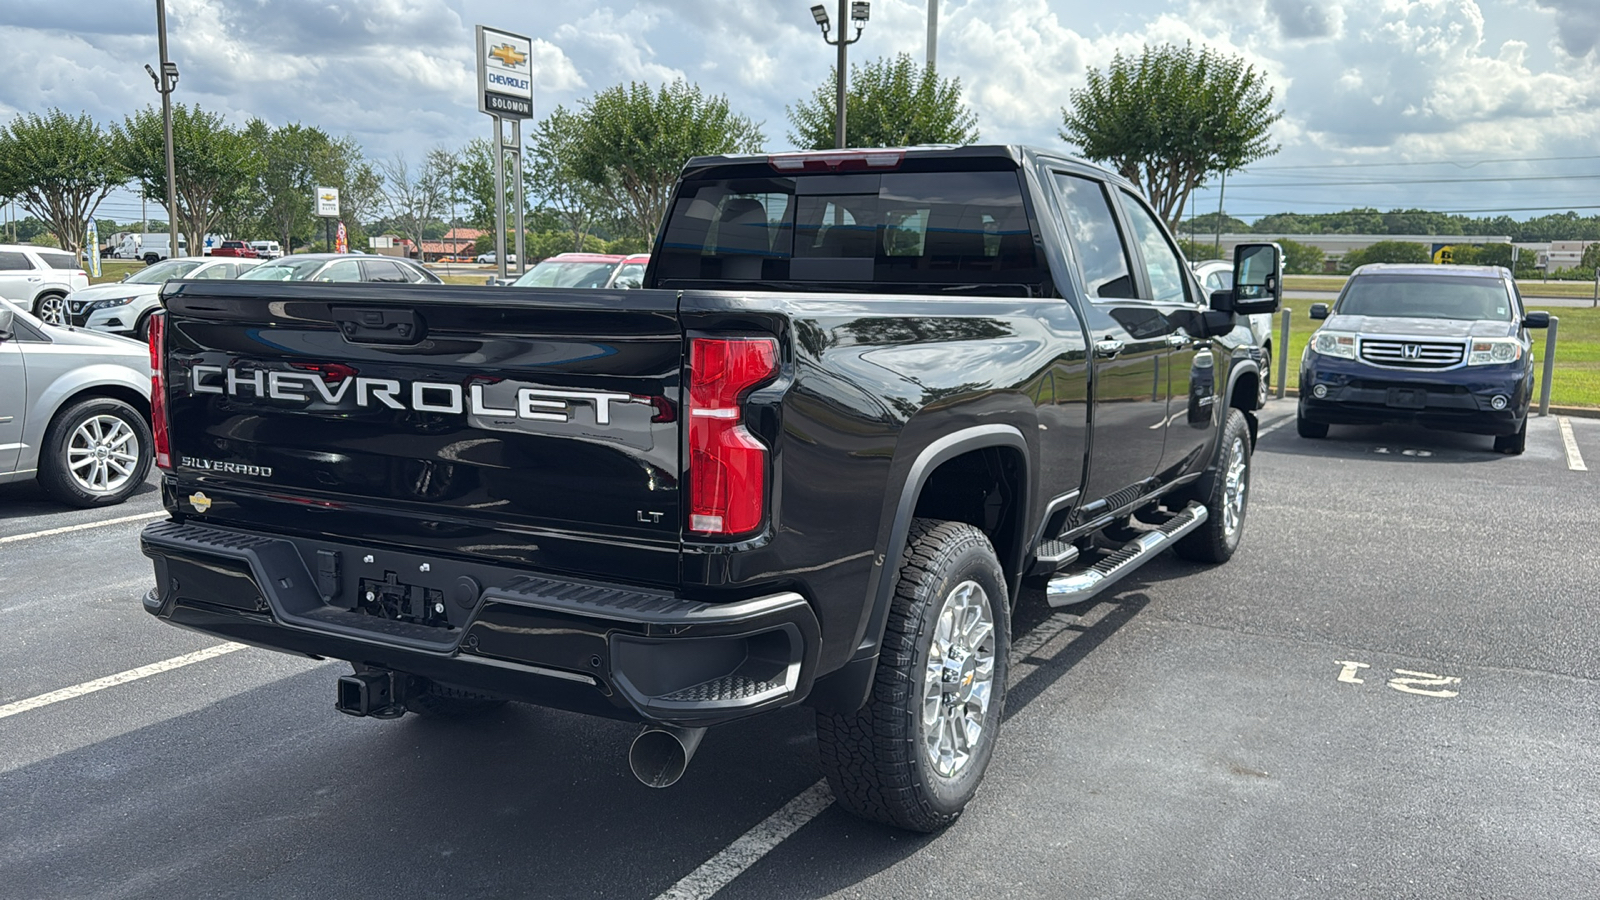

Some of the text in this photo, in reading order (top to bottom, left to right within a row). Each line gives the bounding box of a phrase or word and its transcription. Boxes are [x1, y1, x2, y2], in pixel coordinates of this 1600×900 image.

[488, 73, 529, 90] CHEVROLET
[492, 98, 529, 113] SOLOMON
[192, 365, 631, 425] CHEVROLET
[181, 456, 273, 478] SILVERADO
[637, 510, 664, 523] LT
